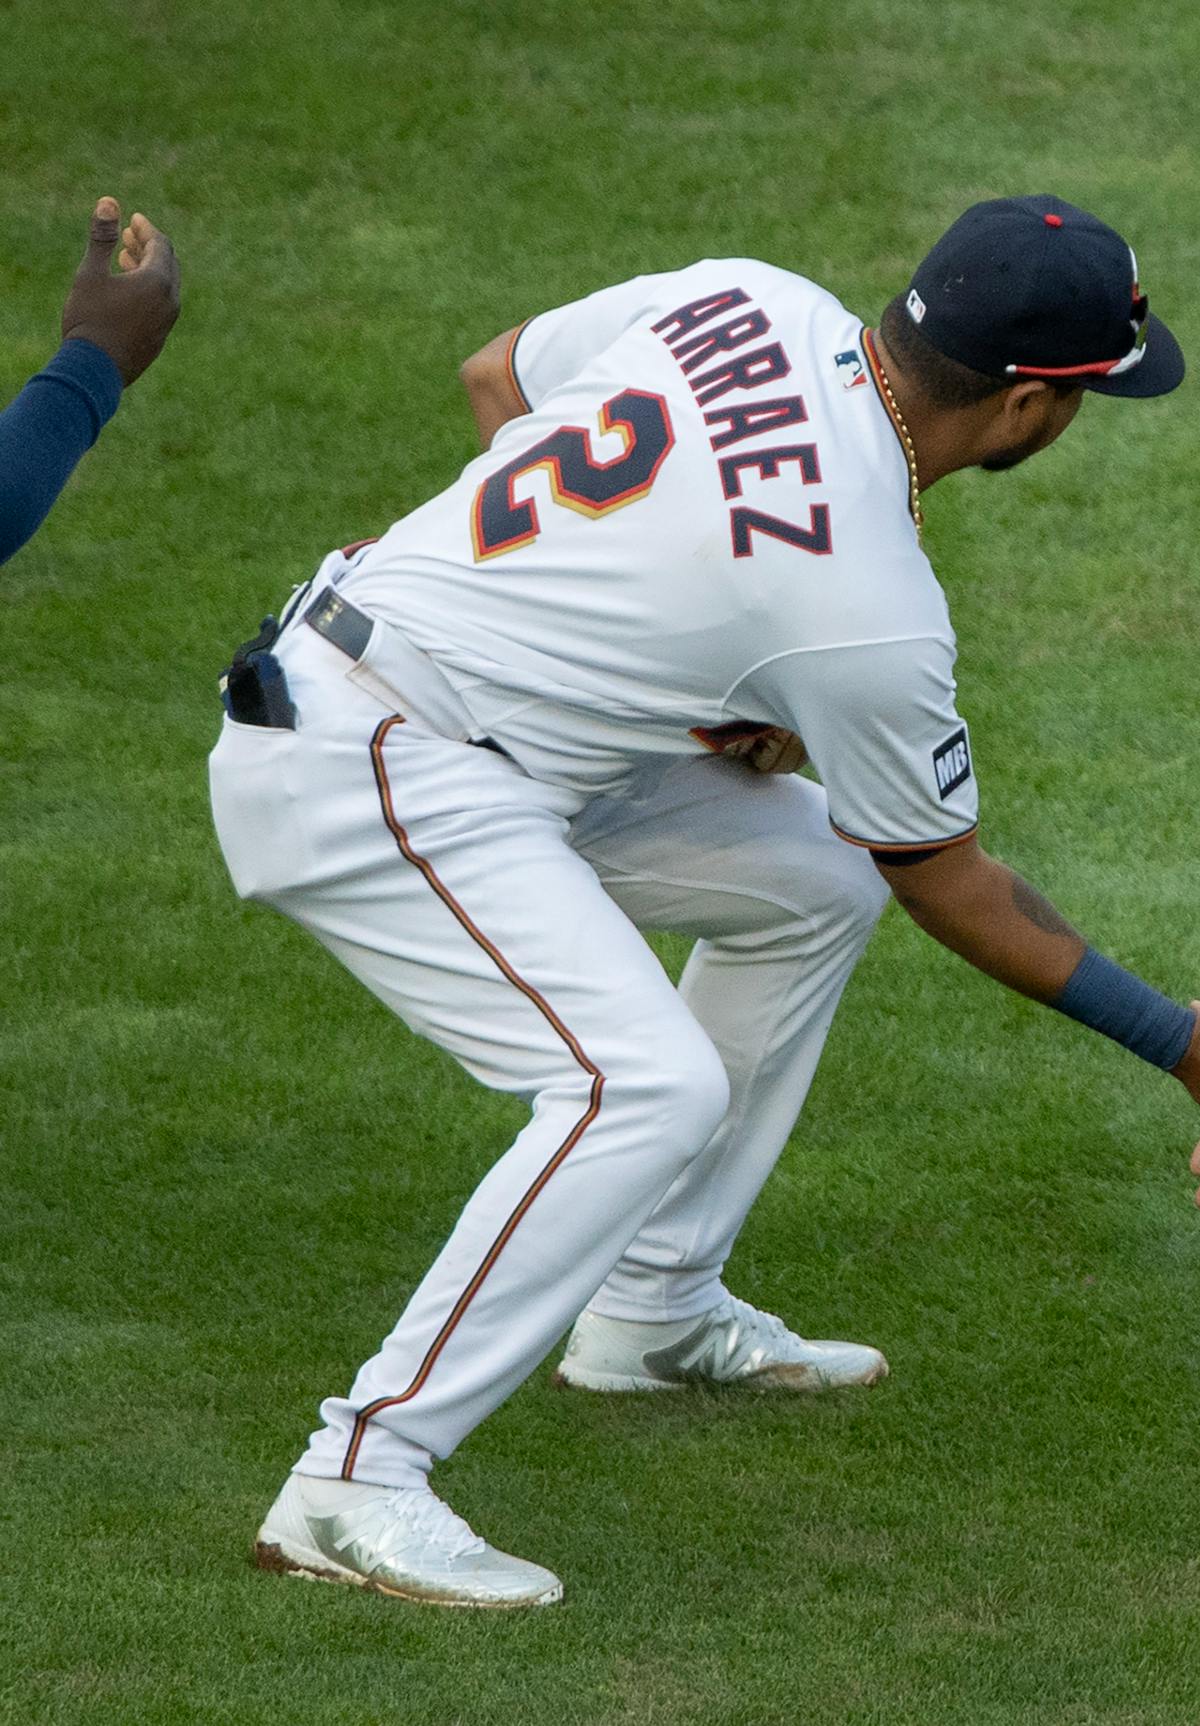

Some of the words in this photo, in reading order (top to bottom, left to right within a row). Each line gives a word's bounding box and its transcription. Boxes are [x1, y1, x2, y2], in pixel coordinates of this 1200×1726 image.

[470, 387, 676, 563] 2
[650, 287, 833, 559] ARRAEZ
[935, 741, 968, 790] MB
